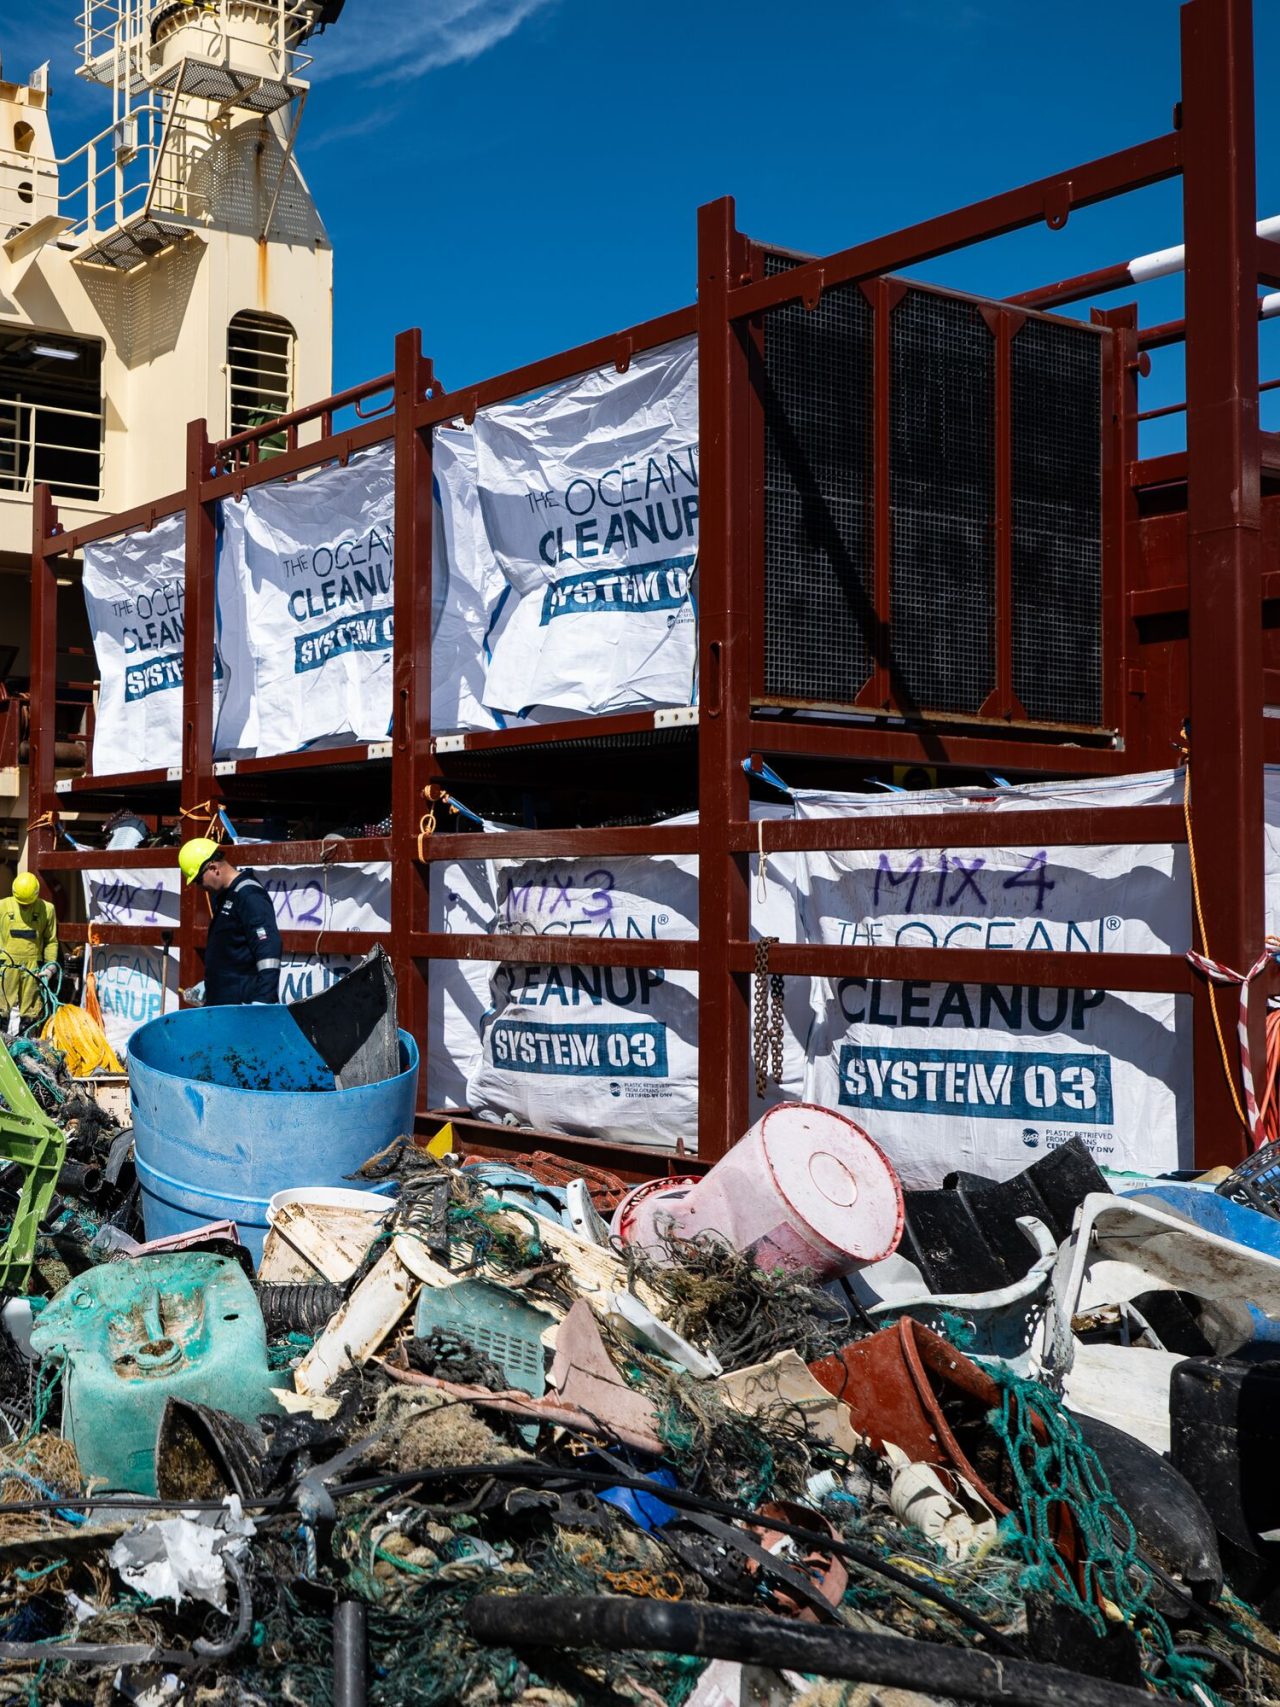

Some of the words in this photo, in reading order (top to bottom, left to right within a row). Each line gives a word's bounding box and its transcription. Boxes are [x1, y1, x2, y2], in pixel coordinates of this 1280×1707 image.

[524, 490, 560, 513] THE
[538, 494, 699, 568] CLEANUP
[282, 554, 309, 579] THE
[112, 598, 134, 618] THE
[287, 559, 395, 622] CLEANU
[300, 617, 377, 665] SYSTEM
[95, 877, 143, 921] MIX
[144, 880, 164, 923] 1
[297, 880, 323, 926] 2
[506, 873, 573, 922] MIX
[581, 869, 615, 916] 3
[873, 853, 987, 913] MIX
[1002, 850, 1055, 911] 4
[838, 921, 883, 946] THE
[837, 977, 1106, 1032] CLEANUP
[495, 1029, 600, 1066] SYSTEM
[607, 1032, 655, 1067] 03
[845, 1058, 1013, 1105] SYSTEM
[1024, 1065, 1097, 1110] 03
[1045, 1129, 1073, 1137] PLASTIC
